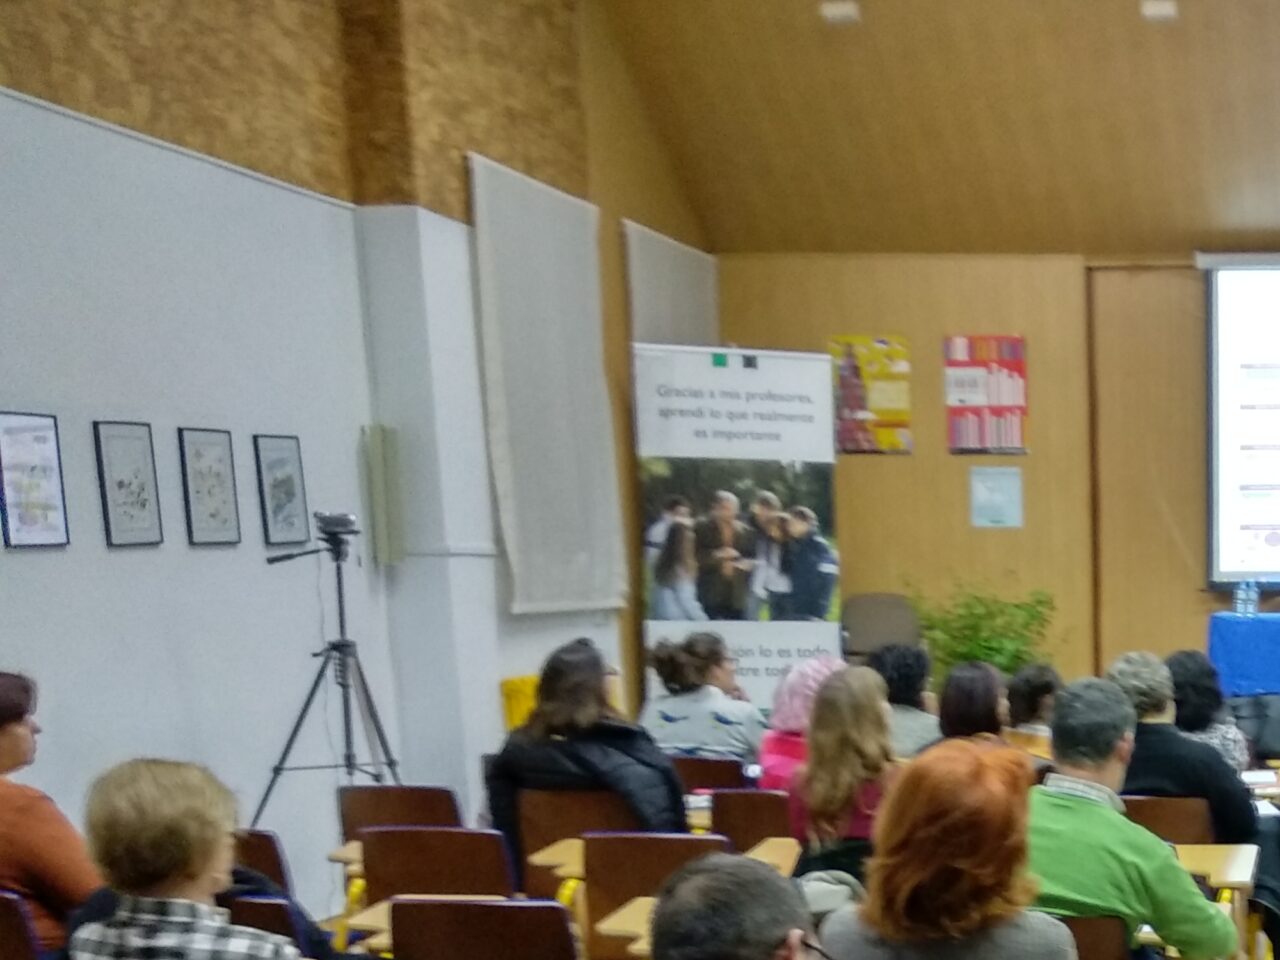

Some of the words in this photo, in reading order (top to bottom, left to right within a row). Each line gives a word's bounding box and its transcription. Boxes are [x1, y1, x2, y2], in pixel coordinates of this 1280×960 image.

[656, 384, 704, 399] Gracias
[710, 390, 717, 399] a
[709, 408, 722, 419] lo
[725, 410, 749, 423] que
[753, 411, 816, 424] realmente
[693, 429, 708, 440] es
[712, 429, 782, 442] importante
[758, 644, 773, 658] lo
[776, 648, 792, 658] es
